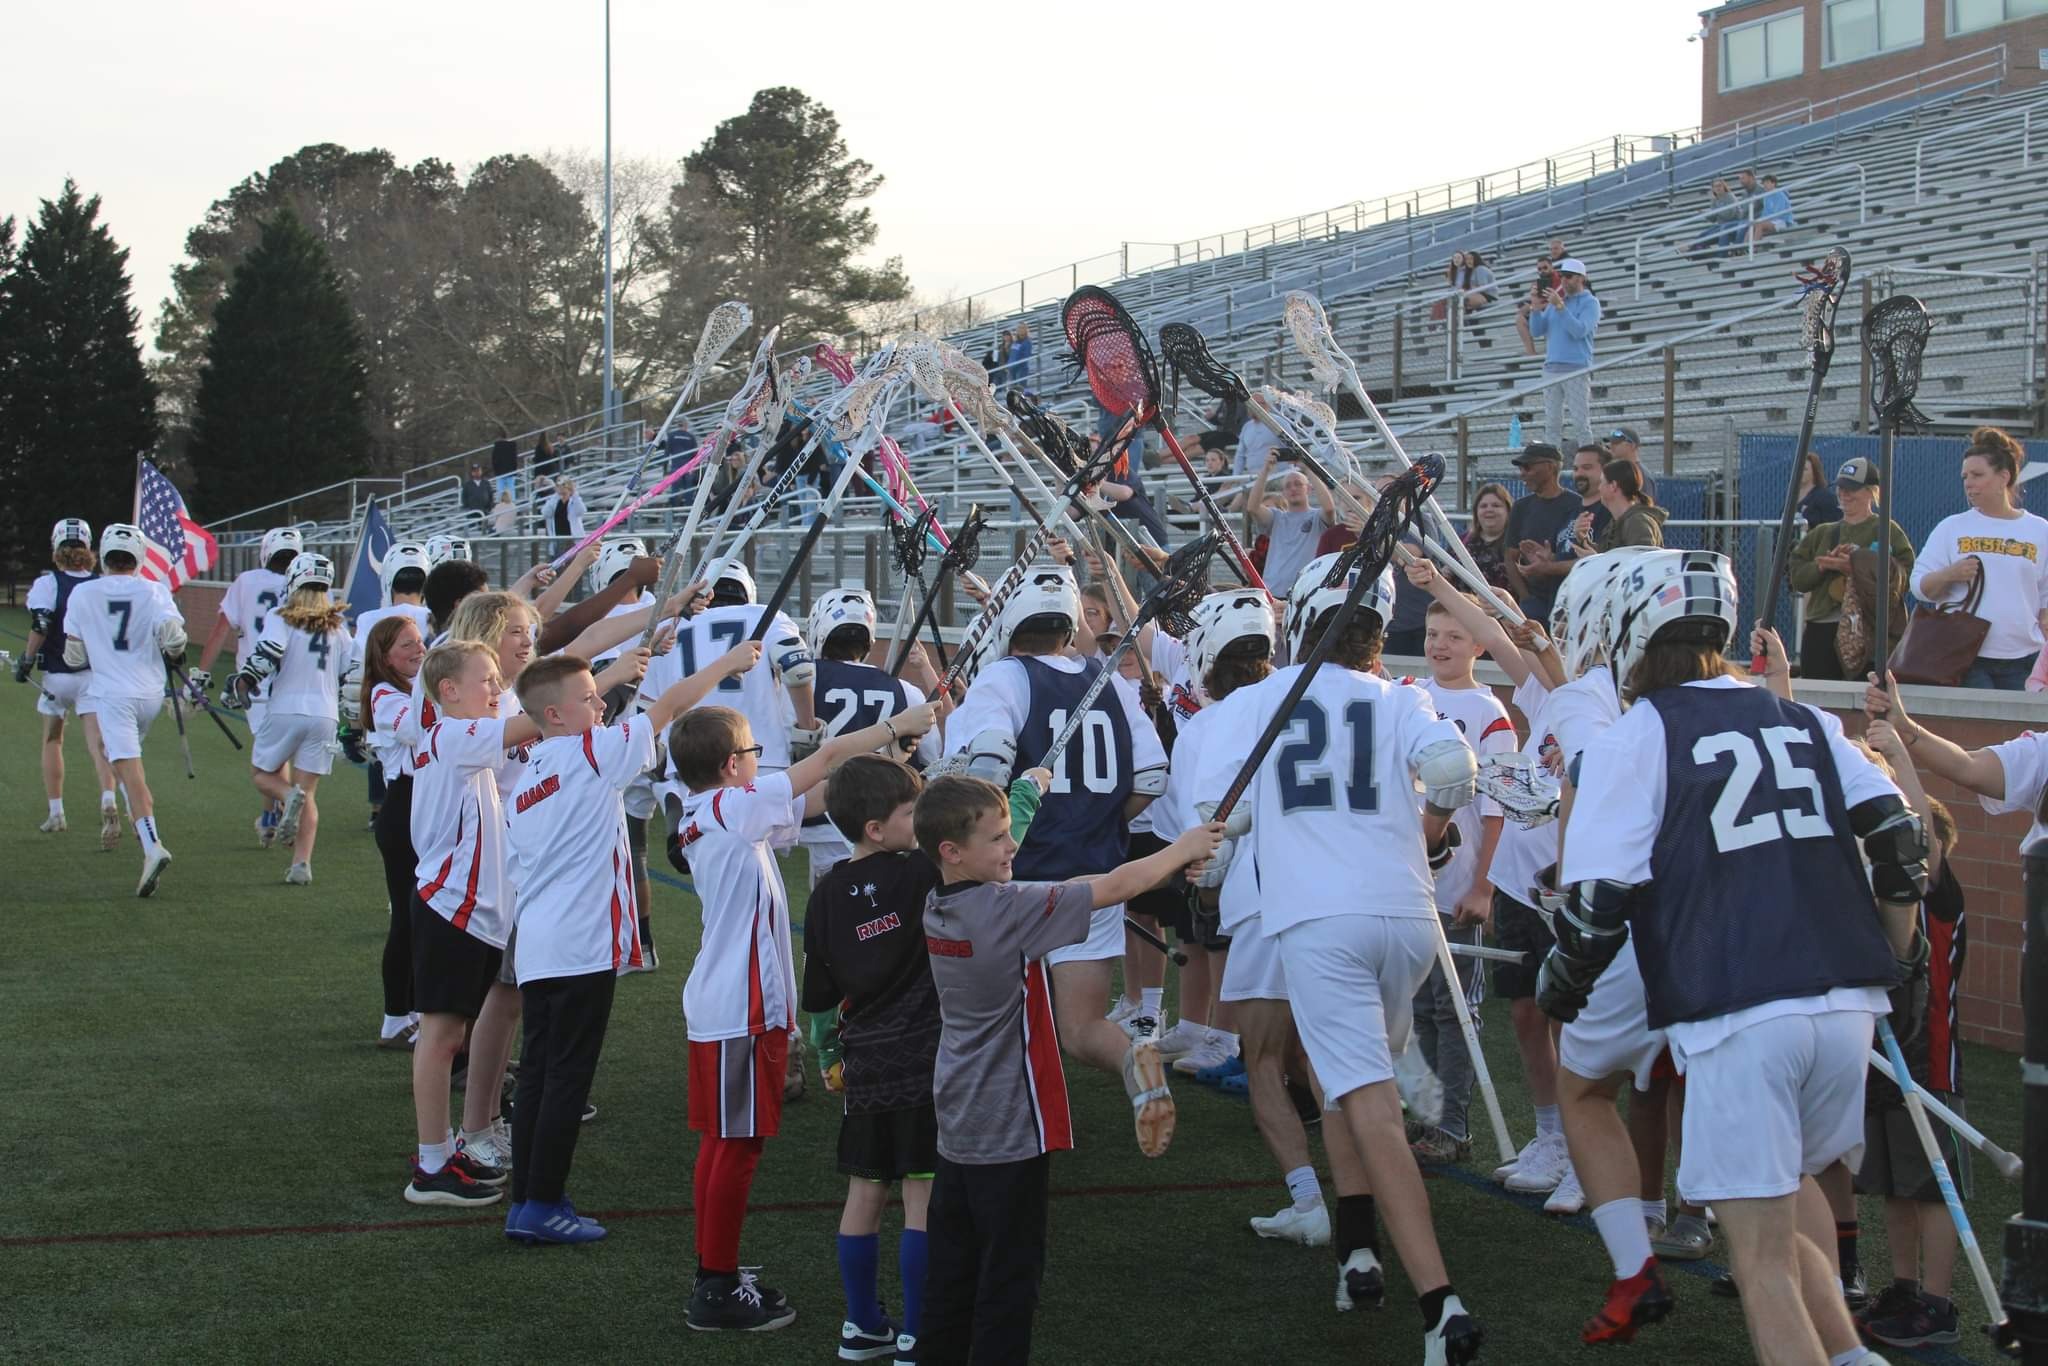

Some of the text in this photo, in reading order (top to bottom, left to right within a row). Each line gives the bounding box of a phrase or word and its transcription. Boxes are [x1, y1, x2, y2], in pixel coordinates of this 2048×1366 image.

[1621, 565, 1646, 601] 25
[107, 600, 131, 651] 7
[308, 630, 330, 671] 4
[676, 618, 747, 693] 17
[824, 688, 895, 738] 27
[1053, 671, 1111, 755] UNDER ARMOUR
[1049, 708, 1118, 793] 10
[1274, 696, 1380, 816] 21
[1692, 726, 1834, 853] 25
[856, 912, 901, 942] RYAN
